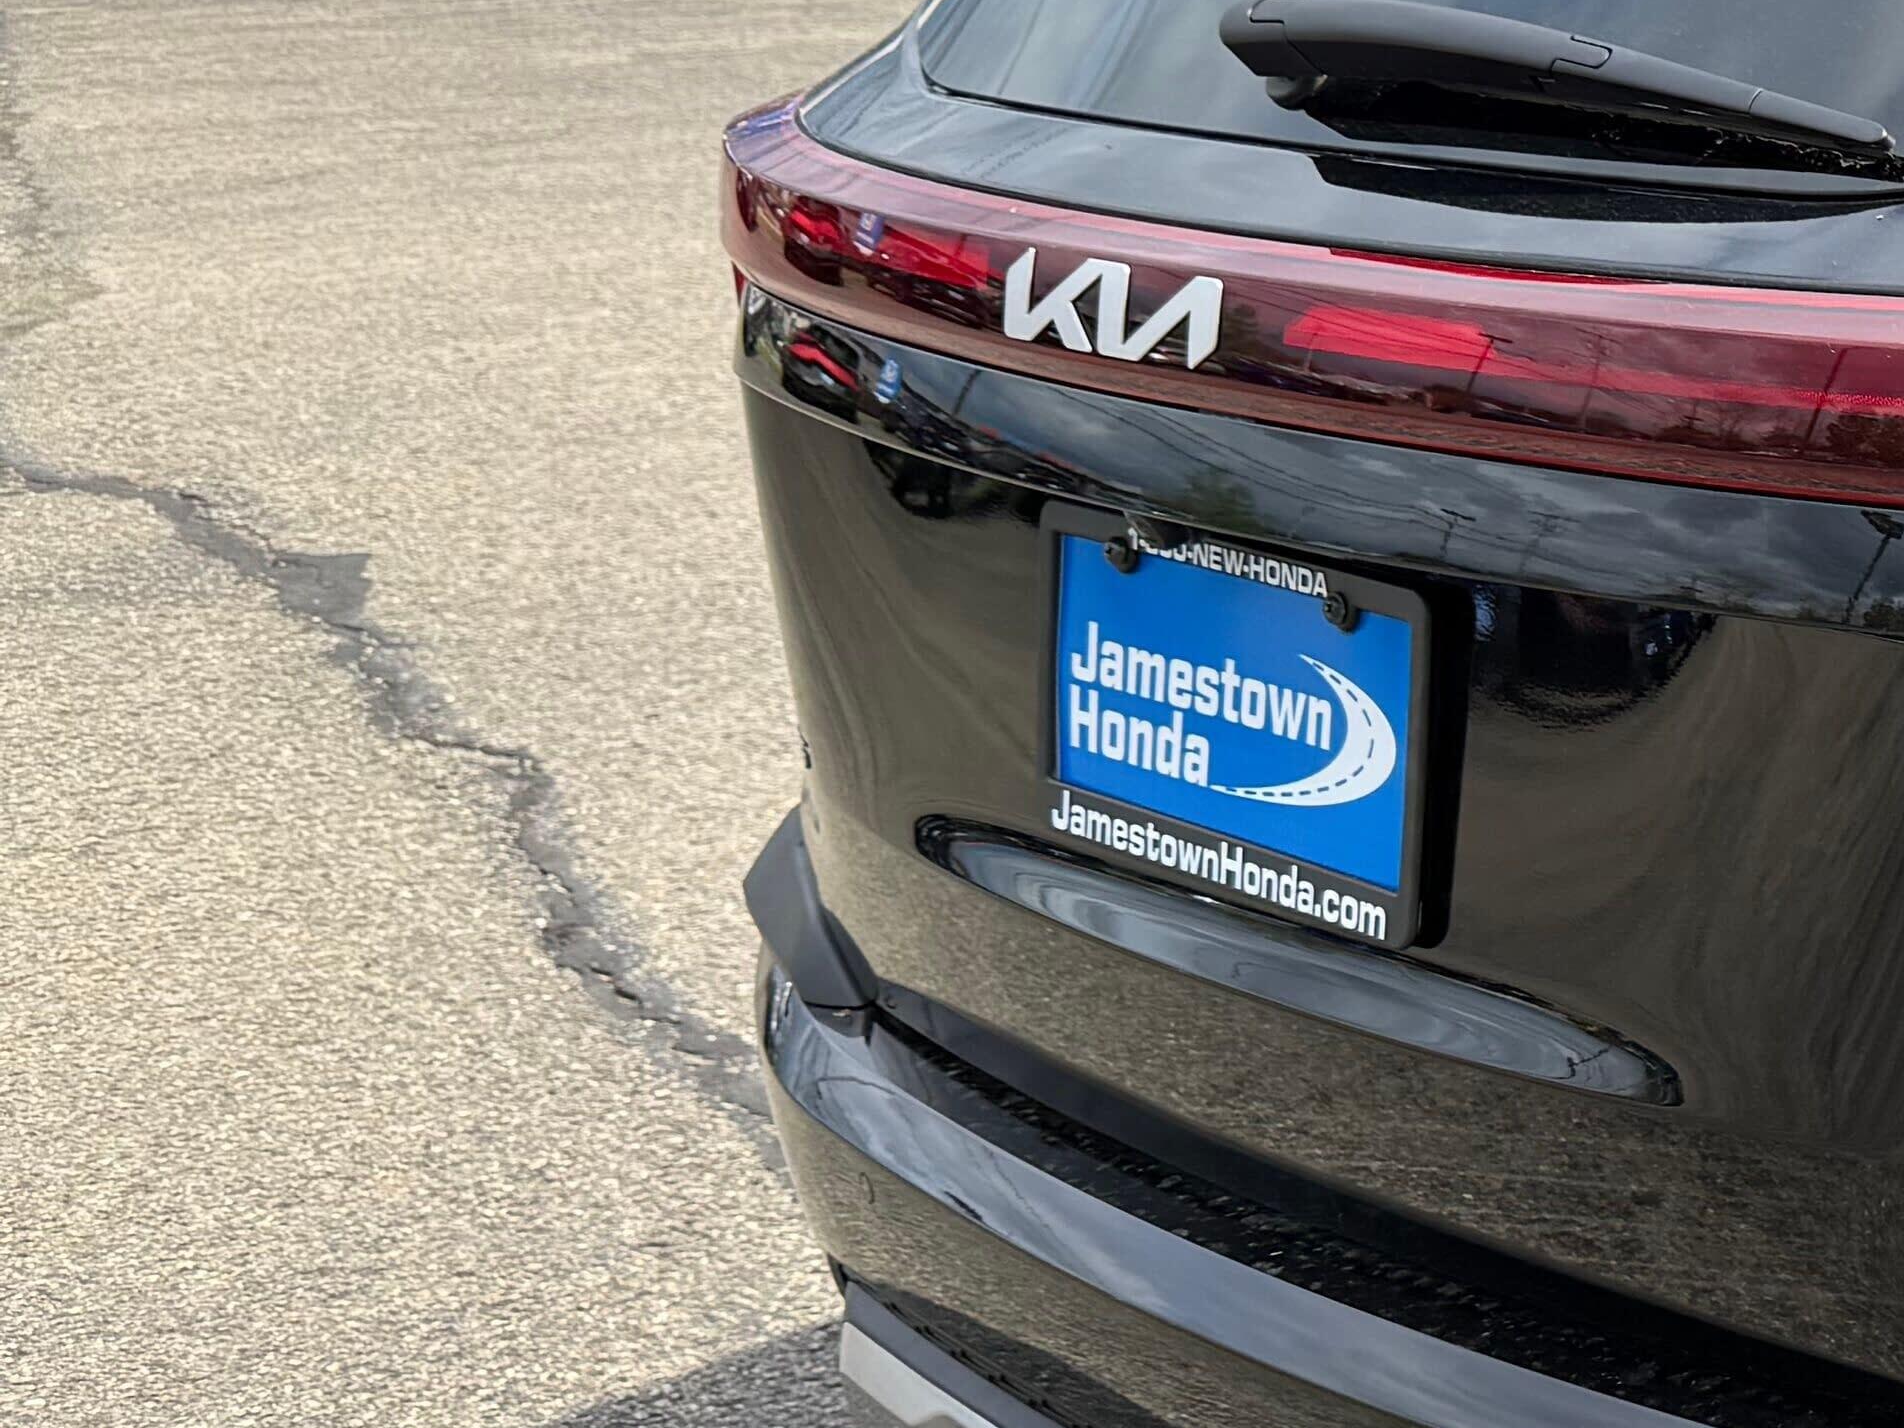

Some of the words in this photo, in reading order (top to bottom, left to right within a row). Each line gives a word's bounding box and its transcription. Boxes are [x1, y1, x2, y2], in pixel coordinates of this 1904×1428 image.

[1003, 246, 1224, 370] KIA
[1070, 684, 1211, 787] Honda
[1071, 621, 1332, 751] Jamestown
[1051, 789, 1386, 941] JamestownHonda.com
